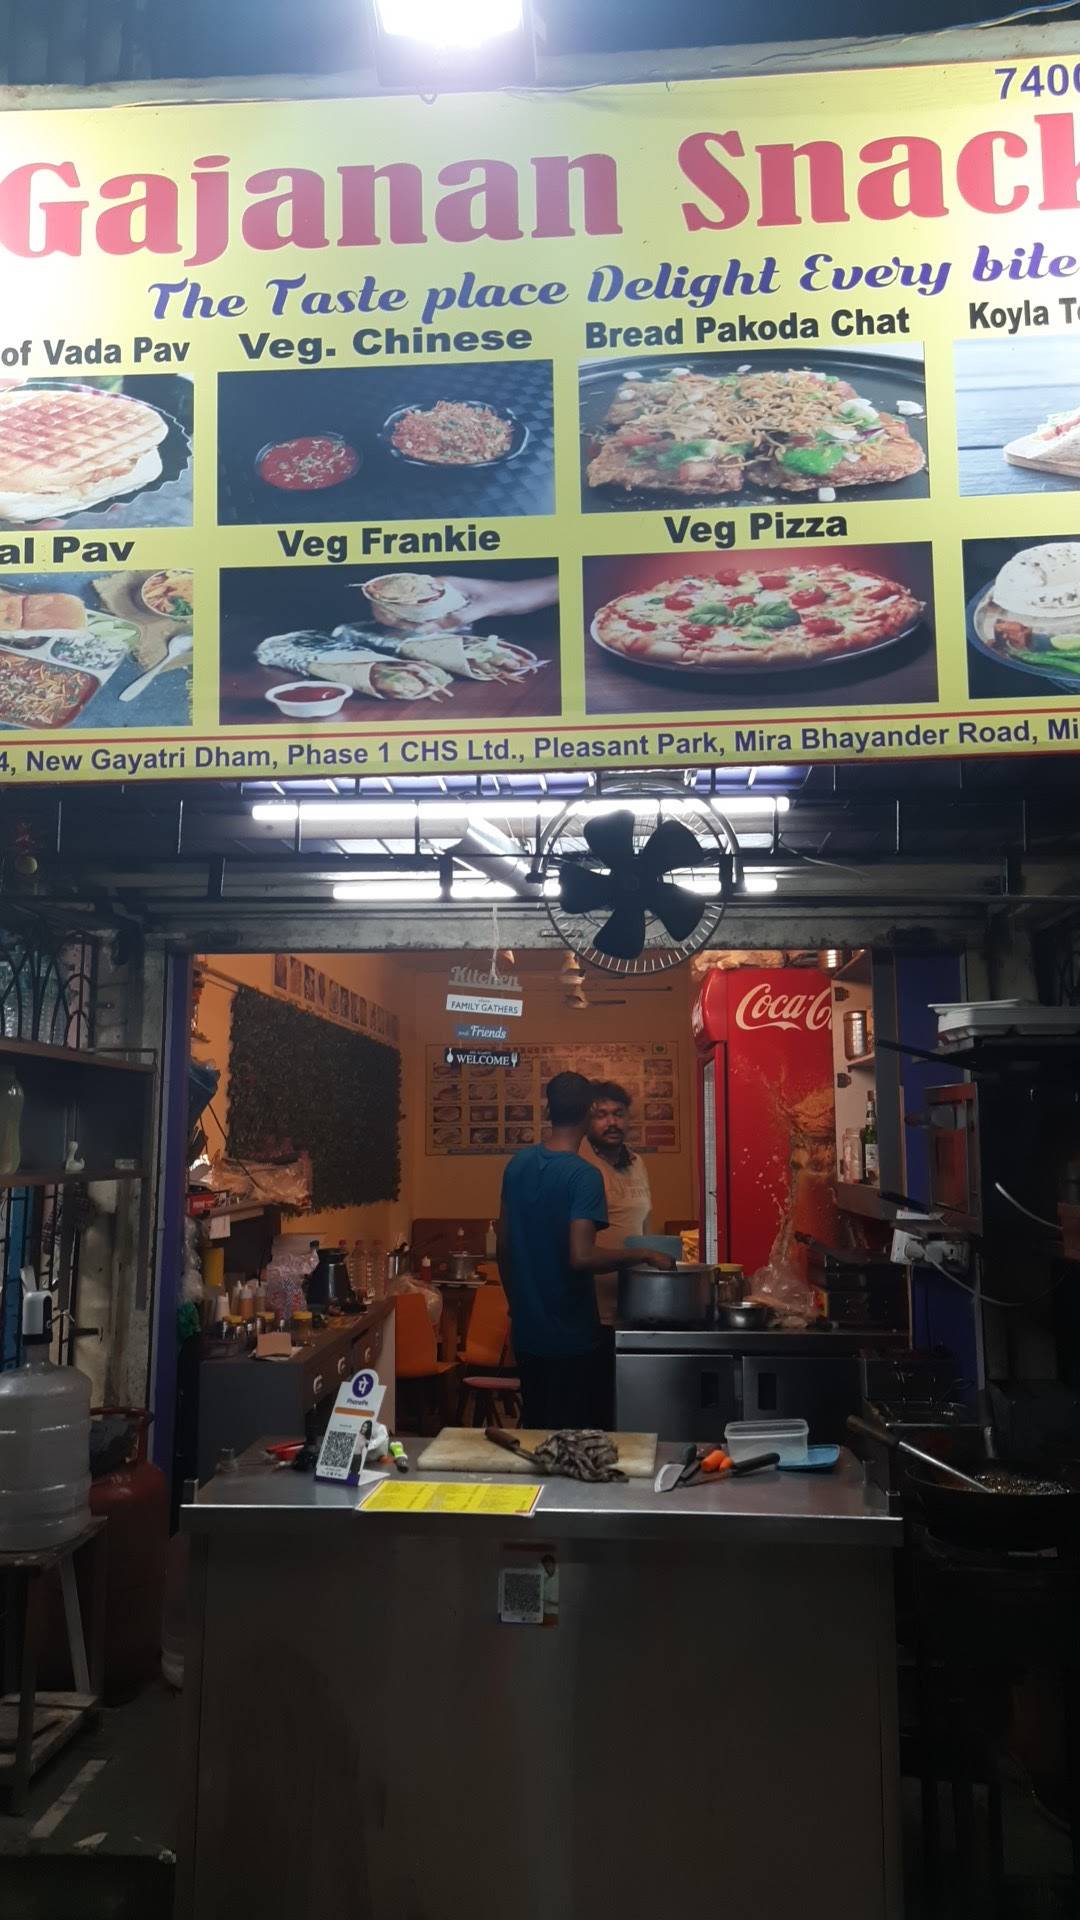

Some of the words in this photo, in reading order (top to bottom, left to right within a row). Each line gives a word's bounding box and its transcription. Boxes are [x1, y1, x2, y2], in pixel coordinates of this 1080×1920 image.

[0, 154, 623, 267] Gajanan
[148, 277, 248, 320] The
[266, 273, 409, 317] Taste
[421, 271, 569, 325] place
[587, 256, 781, 308] Delight
[799, 253, 952, 296] Every
[972, 242, 1078, 283] bite
[585, 316, 684, 349] Bread
[696, 311, 820, 344] Pakoda
[831, 306, 910, 336] Chat
[969, 299, 1050, 335] Koyla
[1058, 297, 1080, 324] T
[1, 339, 32, 367] of
[44, 338, 122, 366] Vada
[134, 335, 190, 362] Pav
[239, 329, 337, 365] Veg.
[352, 326, 533, 356] Chinese
[277, 529, 349, 563] Veg
[361, 523, 502, 555] Frankie
[663, 515, 736, 549] Veg
[749, 510, 848, 541] Pizza
[53, 536, 135, 564] Pav
[26, 750, 83, 772] New
[91, 746, 186, 775] Gayatri
[194, 744, 278, 773] Dham,
[287, 743, 369, 767] Phase
[378, 740, 390, 764] 1
[400, 738, 459, 764] CHS
[467, 737, 525, 764] Ltd.,
[534, 735, 649, 761] Pleasant
[657, 732, 726, 758] Park,
[734, 728, 792, 754] Mira
[801, 724, 950, 756] Bhayander
[958, 719, 1038, 748] Road,
[1047, 718, 1079, 740] Mi
[451, 966, 520, 987] Kitchen
[451, 1000, 479, 1011] FAMILY
[481, 1004, 519, 1014] GATHERS
[735, 983, 833, 1031] Coca-C
[470, 1025, 507, 1039] Friends
[457, 1054, 510, 1066] WELCOME
